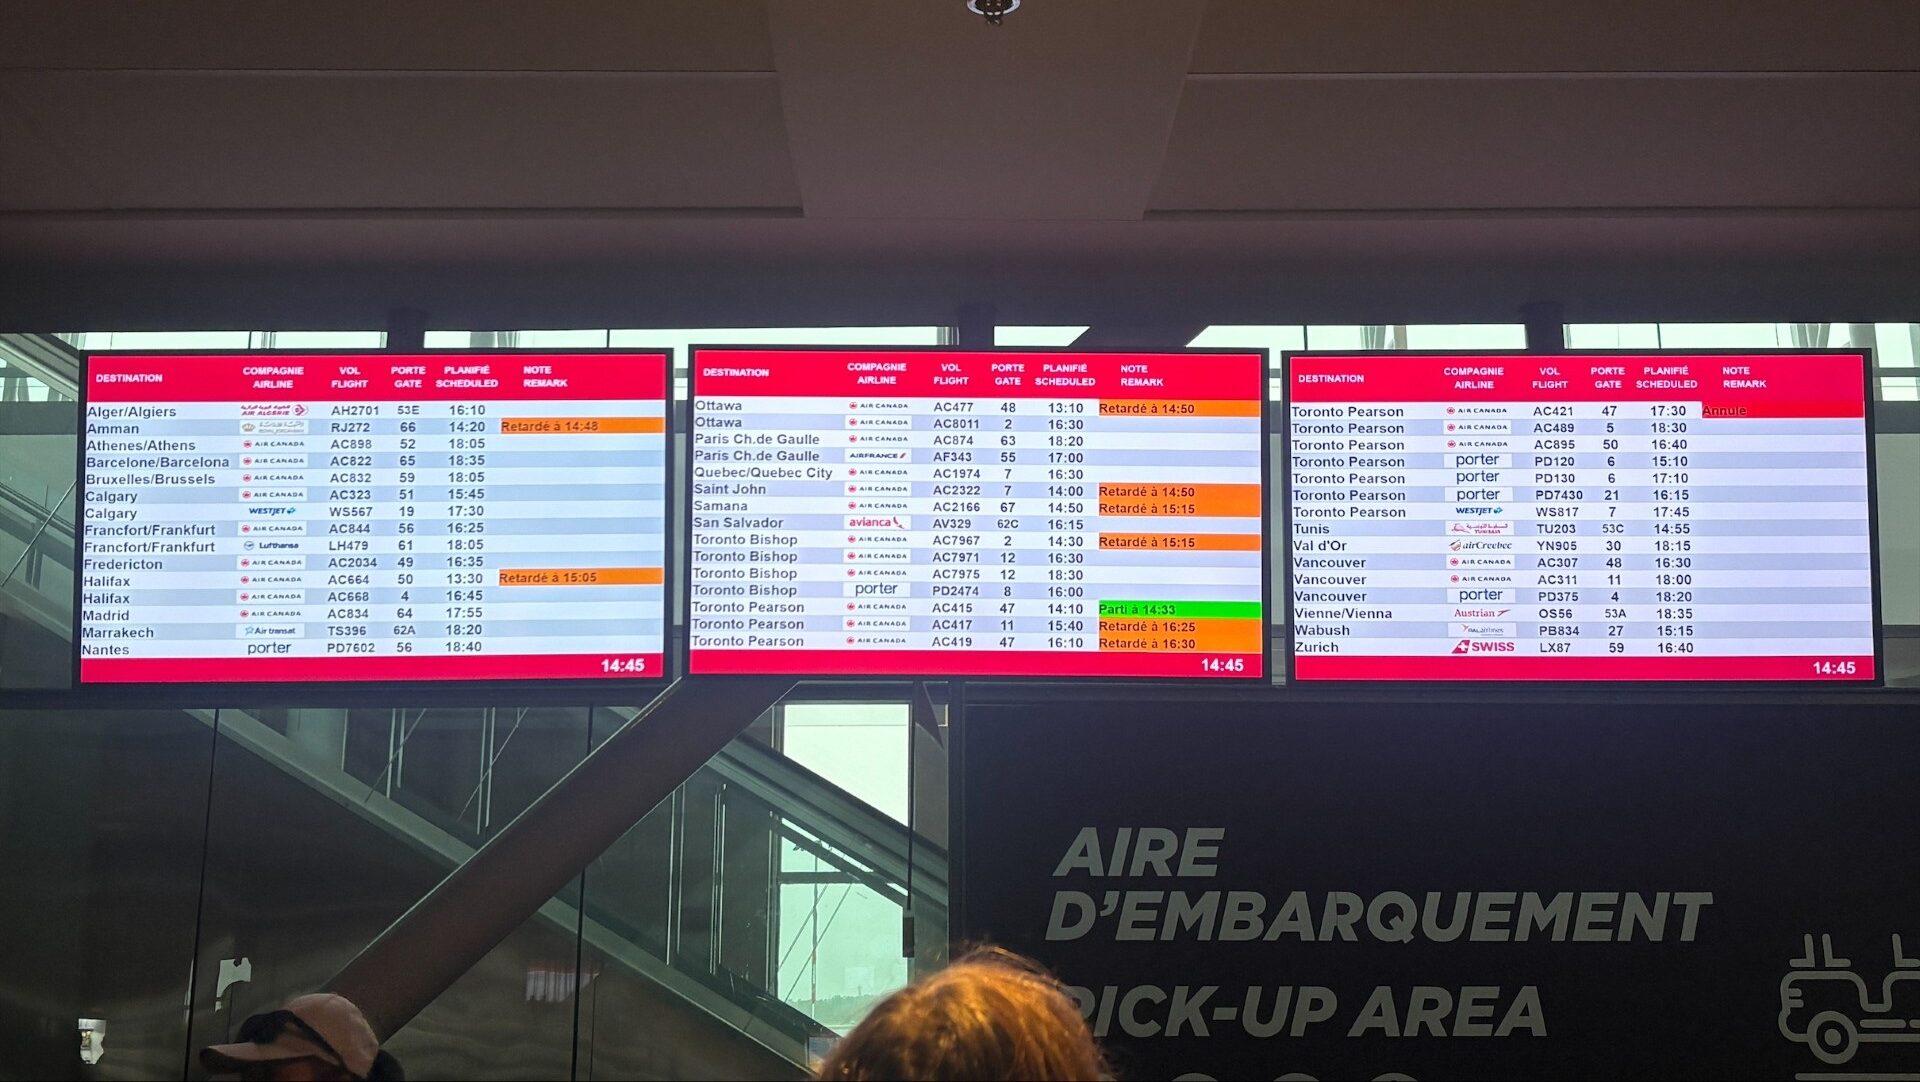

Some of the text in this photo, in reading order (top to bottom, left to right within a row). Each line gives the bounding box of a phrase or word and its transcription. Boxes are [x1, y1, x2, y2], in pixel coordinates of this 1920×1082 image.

[243, 366, 304, 375] COMPAGNIE
[339, 366, 361, 375] VOL
[391, 366, 426, 375] PORTE
[444, 365, 490, 375] PLANIFIÉ
[523, 366, 552, 374] NOTE
[703, 368, 769, 377] DESTINATION
[847, 363, 906, 371] COMPAGNIE
[941, 363, 961, 372] VOL
[991, 363, 1024, 372] PORTE
[1043, 363, 1087, 373] PLANIFIÉ
[1120, 365, 1148, 373] NOTE
[1444, 367, 1504, 376] COMPAGNIE
[1539, 367, 1560, 376] VOL
[1591, 367, 1625, 375] PORTE
[1644, 366, 1689, 375] PLANIFIÉ
[1722, 366, 1750, 375] NOTE
[96, 374, 163, 383] DESTINATION
[331, 380, 368, 388] FLIGHT
[394, 379, 422, 388] GATE
[436, 379, 499, 388] SCHEDULED
[523, 379, 567, 387] REMARK
[857, 376, 896, 384] AIRLINE
[933, 376, 969, 385] FLIGHT
[995, 377, 1021, 386] GATE
[1035, 377, 1096, 386] SCHEDULED
[1121, 378, 1163, 386] REMARK
[1298, 374, 1364, 383] DESTINATION
[1595, 380, 1622, 388] GATE
[1723, 380, 1766, 388] REMARK
[253, 380, 293, 389] AIRLINE
[1454, 381, 1494, 389] AIRLINE
[1532, 380, 1568, 389] FLIGHT
[1636, 380, 1698, 389] SCHEDULED
[331, 405, 379, 416] AH2701
[397, 405, 420, 415] 53E
[693, 400, 742, 411] Ottawa
[934, 402, 974, 412] AC477
[1533, 406, 1573, 416] AC421
[87, 406, 176, 420] Alger/Algiers
[86, 423, 139, 434] Amman
[449, 421, 485, 432] 14:20
[1048, 419, 1084, 430] 16:30
[1651, 422, 1687, 433] 18:30
[695, 433, 820, 445] Paris Ch.de Gaulle
[1000, 435, 1016, 446] 63
[1603, 439, 1618, 450] 50
[85, 440, 196, 451] Athenes/Athens
[86, 456, 229, 468] Barcelone/Barcelona
[330, 456, 372, 466] AC822
[933, 452, 972, 462] AF343
[1292, 456, 1405, 467] Toronto Pearson
[1535, 456, 1575, 467] PD120
[86, 473, 215, 485] Bruxelles/Brussels
[448, 471, 485, 483] 18:05
[694, 466, 833, 481] Quebec/Quebec City
[1048, 469, 1084, 480] 16:30
[1456, 470, 1499, 485] porter
[1652, 473, 1689, 483] 17:10
[694, 483, 766, 494] Saint John
[85, 491, 138, 504] Calgary
[399, 489, 413, 500] 51
[694, 500, 748, 511] Samana
[249, 508, 285, 517] WESTJET
[1456, 508, 1491, 516] WESTJET
[694, 517, 784, 529] San Salvador
[849, 517, 891, 527] avianca
[933, 518, 971, 529] AV329
[997, 519, 1019, 529] 62C
[84, 524, 215, 536] Francfort/Frankfurt
[328, 523, 370, 534] AC844
[1293, 523, 1330, 534] Tunis
[1536, 524, 1576, 534] TU203
[1602, 523, 1624, 534] 53C
[447, 539, 484, 550] 18:05
[694, 533, 798, 547] Toronto Bishop
[1048, 536, 1083, 547] 14:30
[1293, 540, 1347, 551] Val d'Or
[1655, 540, 1691, 551] 18:15
[84, 558, 163, 570] Fredericton
[1293, 557, 1366, 568] Vancouver
[1606, 557, 1622, 568] 48
[932, 569, 980, 579] AC7975
[1537, 574, 1577, 585] AC311
[84, 576, 130, 587] Halifax
[328, 575, 369, 585] AC664
[446, 590, 483, 601] 16:45
[855, 582, 898, 598] porter
[1048, 586, 1083, 598] 16:00
[1656, 591, 1692, 602] 18:20
[691, 601, 804, 613] Toronto Pearson
[1143, 605, 1176, 615] 14:33
[1454, 608, 1495, 617] Austrian
[82, 610, 129, 621] Madrid
[1294, 608, 1392, 619] Vienne/Vienna
[393, 625, 416, 635] 62A
[1001, 620, 1013, 631] 11
[1294, 624, 1350, 636] Wabush
[82, 627, 154, 638] Marrakech
[446, 641, 482, 652] 18:40
[932, 636, 972, 647] AC419
[1048, 637, 1083, 648] 16:10
[1295, 641, 1339, 653] Zurich
[1472, 641, 1515, 652] SWISS
[81, 644, 129, 655] Nantes
[247, 641, 292, 656] porter
[327, 642, 375, 653] PD7602
[1540, 642, 1571, 653] LX87
[1658, 642, 1694, 653] 16:40
[601, 658, 645, 672] 14:45
[1202, 658, 1244, 672] 14:45
[1813, 661, 1856, 674] 14:45
[1053, 827, 1225, 876] AIRE
[1046, 891, 1713, 943] D'EMBARQUEMENT
[1348, 986, 1546, 1036] AREA
